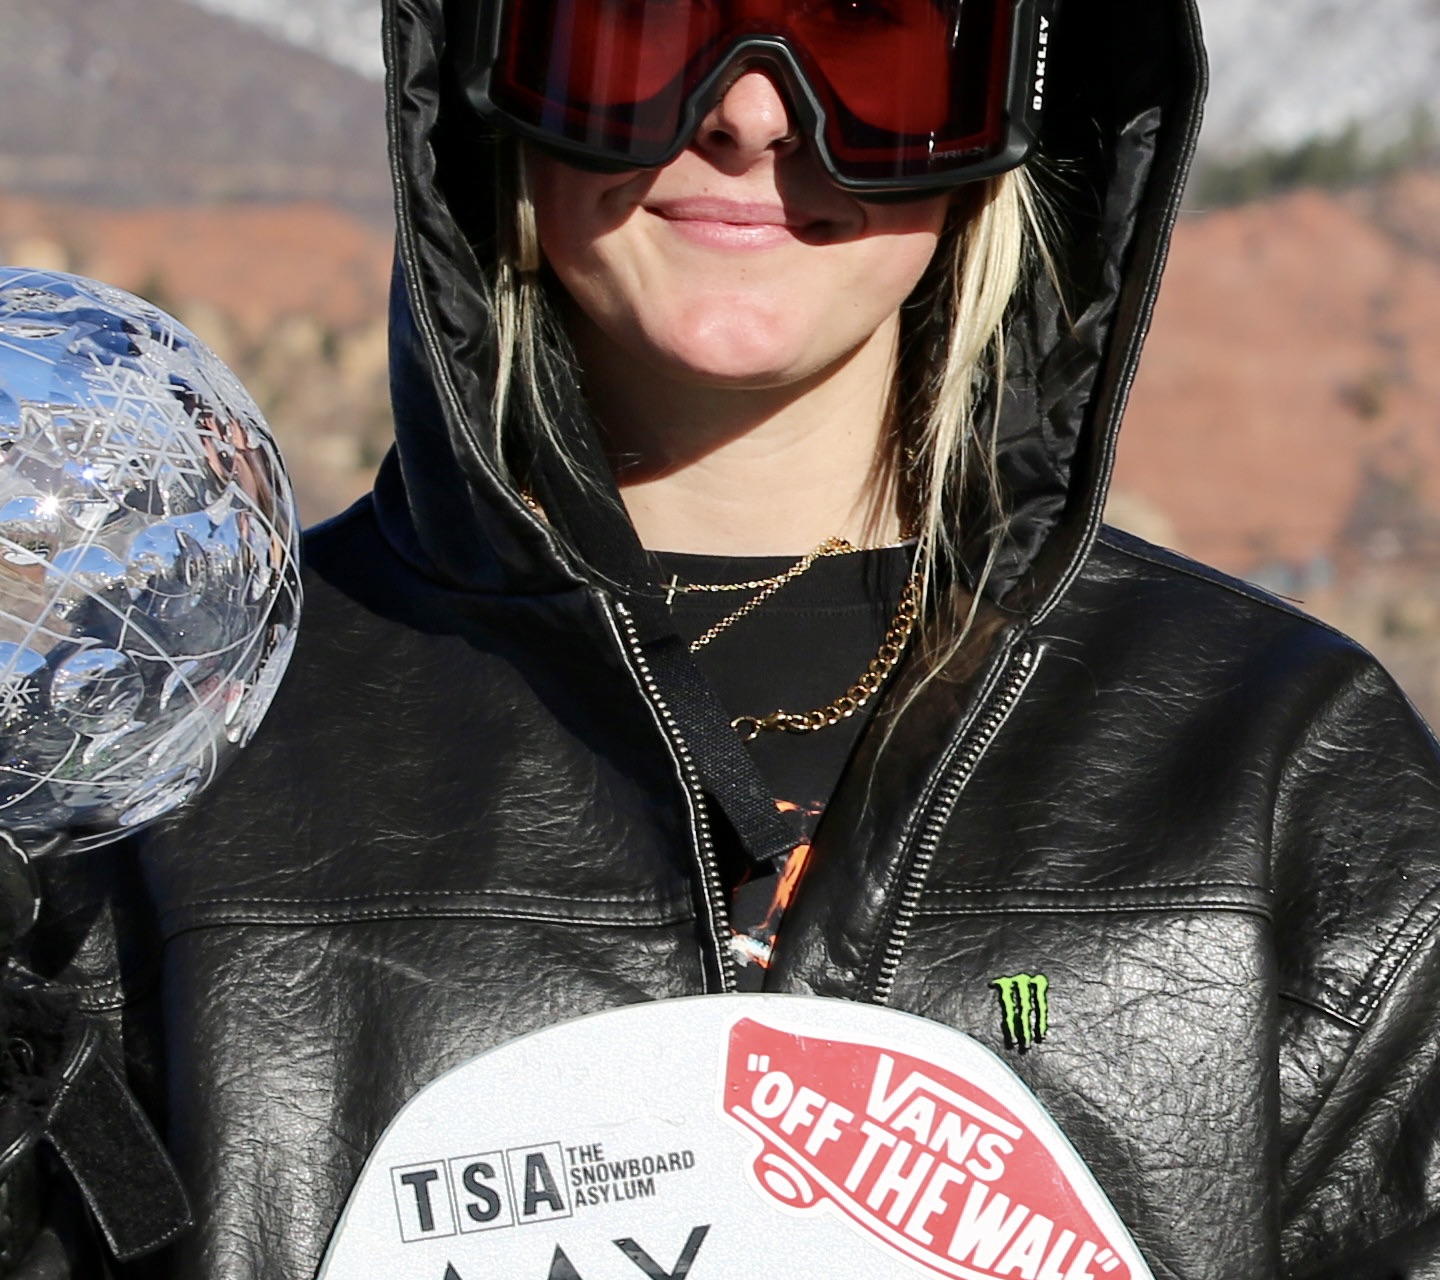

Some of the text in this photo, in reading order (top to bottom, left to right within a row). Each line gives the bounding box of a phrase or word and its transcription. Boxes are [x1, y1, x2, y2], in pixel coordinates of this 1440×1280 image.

[1032, 15, 1050, 111] OAKLEY
[566, 1143, 604, 1166] THE
[866, 1053, 1023, 1182] VANS
[401, 1152, 566, 1232] TSA
[570, 1149, 696, 1187] SNOWBOARD
[574, 1177, 656, 1208] ASYLUM
[844, 1123, 967, 1246] THE
